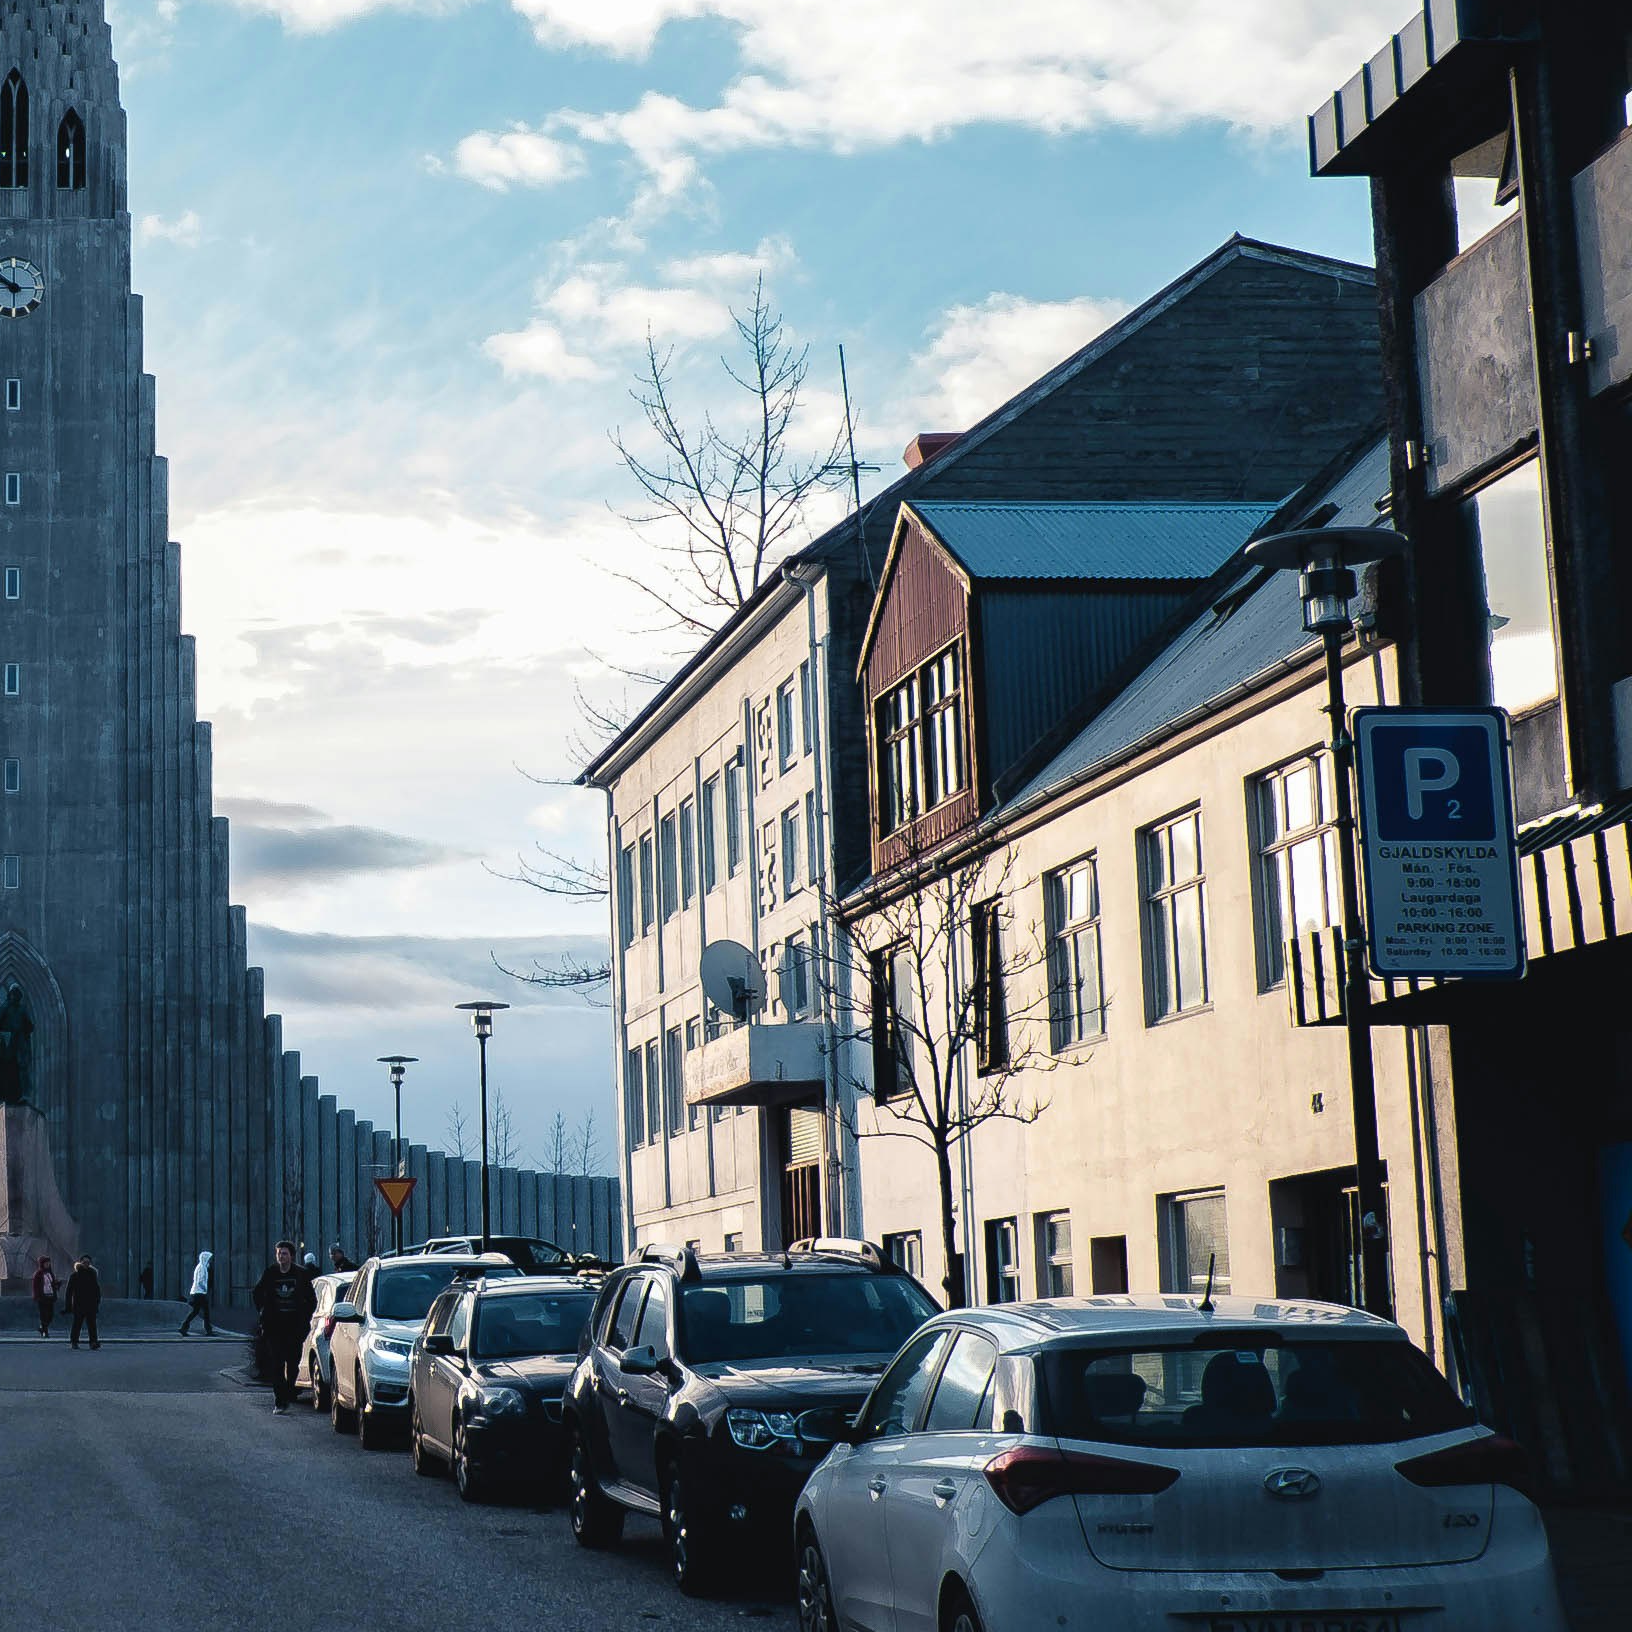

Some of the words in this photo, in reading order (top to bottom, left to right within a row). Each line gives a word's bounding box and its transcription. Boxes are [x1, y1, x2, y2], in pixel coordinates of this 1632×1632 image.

[1404, 747, 1460, 820] P
[1448, 800, 1462, 819] 2
[1379, 847, 1498, 859] GJALDSKYLDA
[1407, 878, 1434, 888] 9:00
[1401, 893, 1481, 905] Laugardaga
[1397, 923, 1455, 934] PARKING
[1457, 923, 1495, 934] ZONE
[1386, 949, 1432, 958] Saturday
